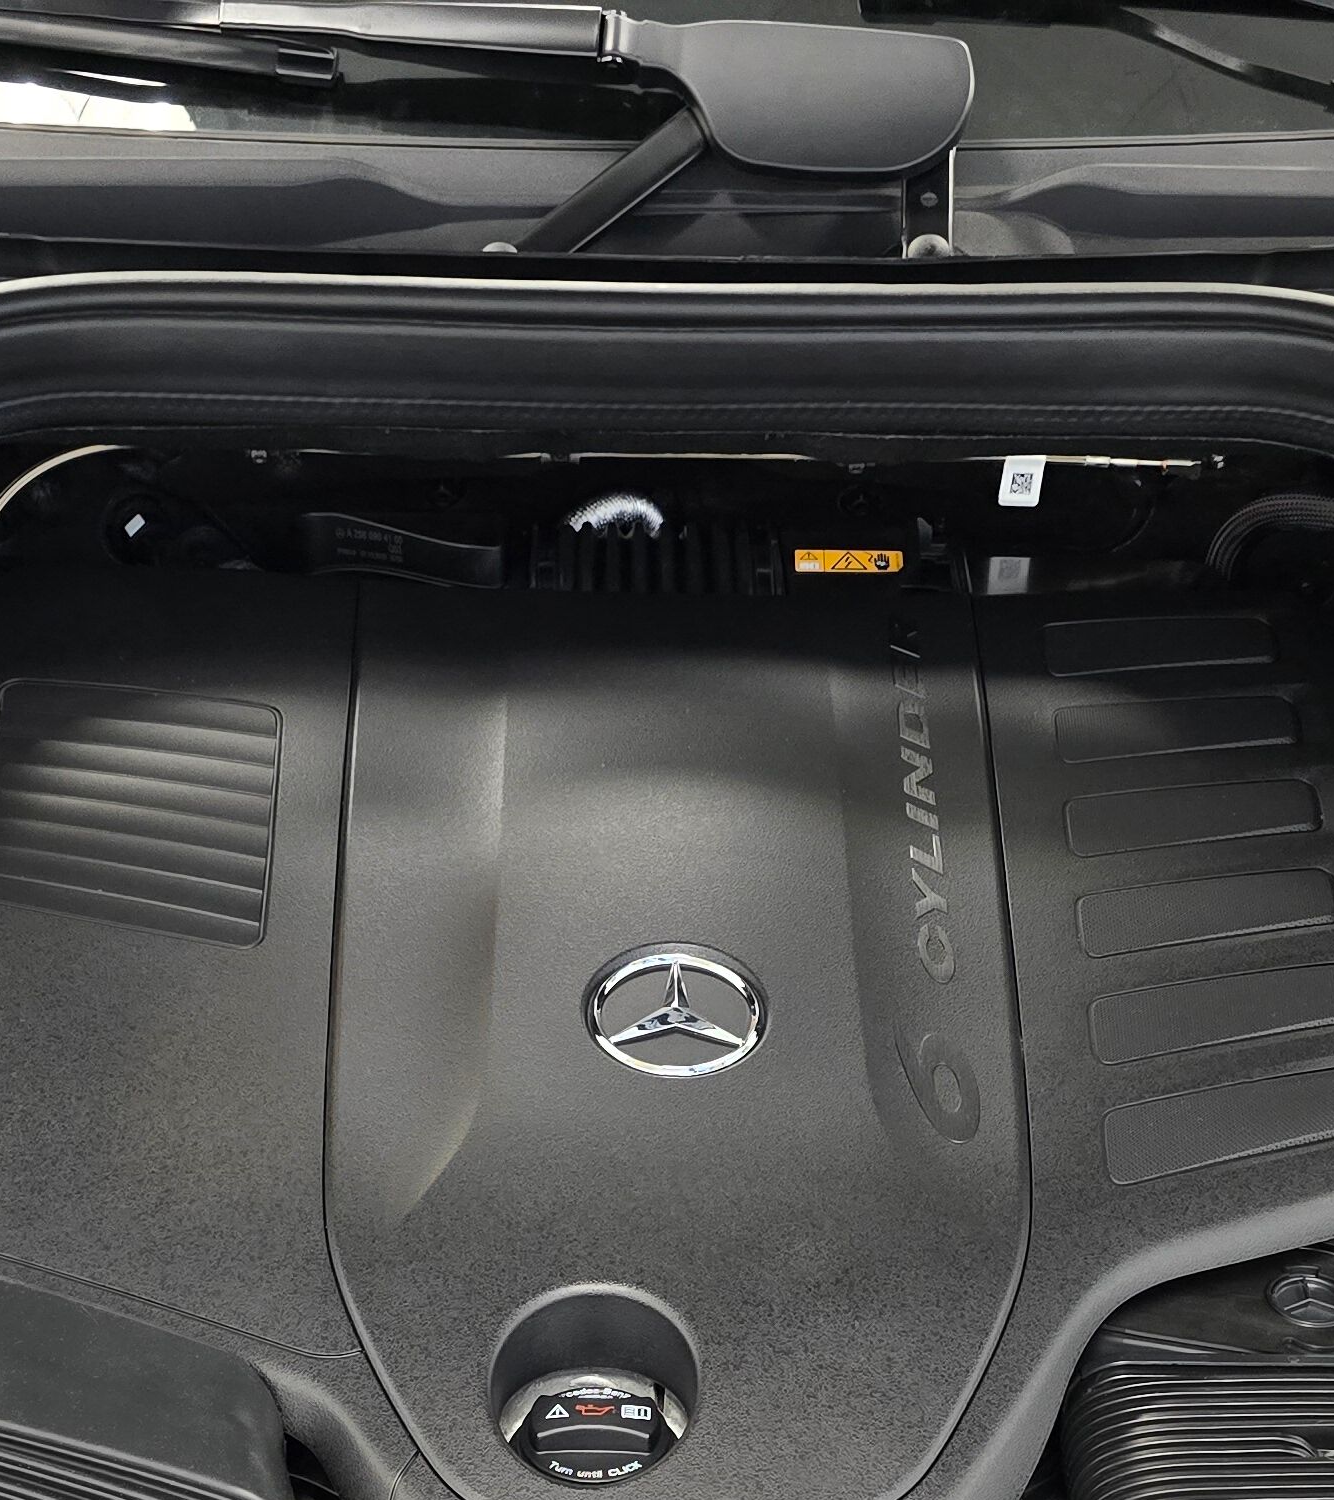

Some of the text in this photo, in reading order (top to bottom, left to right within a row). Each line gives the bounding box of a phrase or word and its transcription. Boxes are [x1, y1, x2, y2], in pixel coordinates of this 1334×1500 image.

[890, 617, 956, 985] CYLINDER
[549, 1460, 643, 1479] Turn until CLICK
